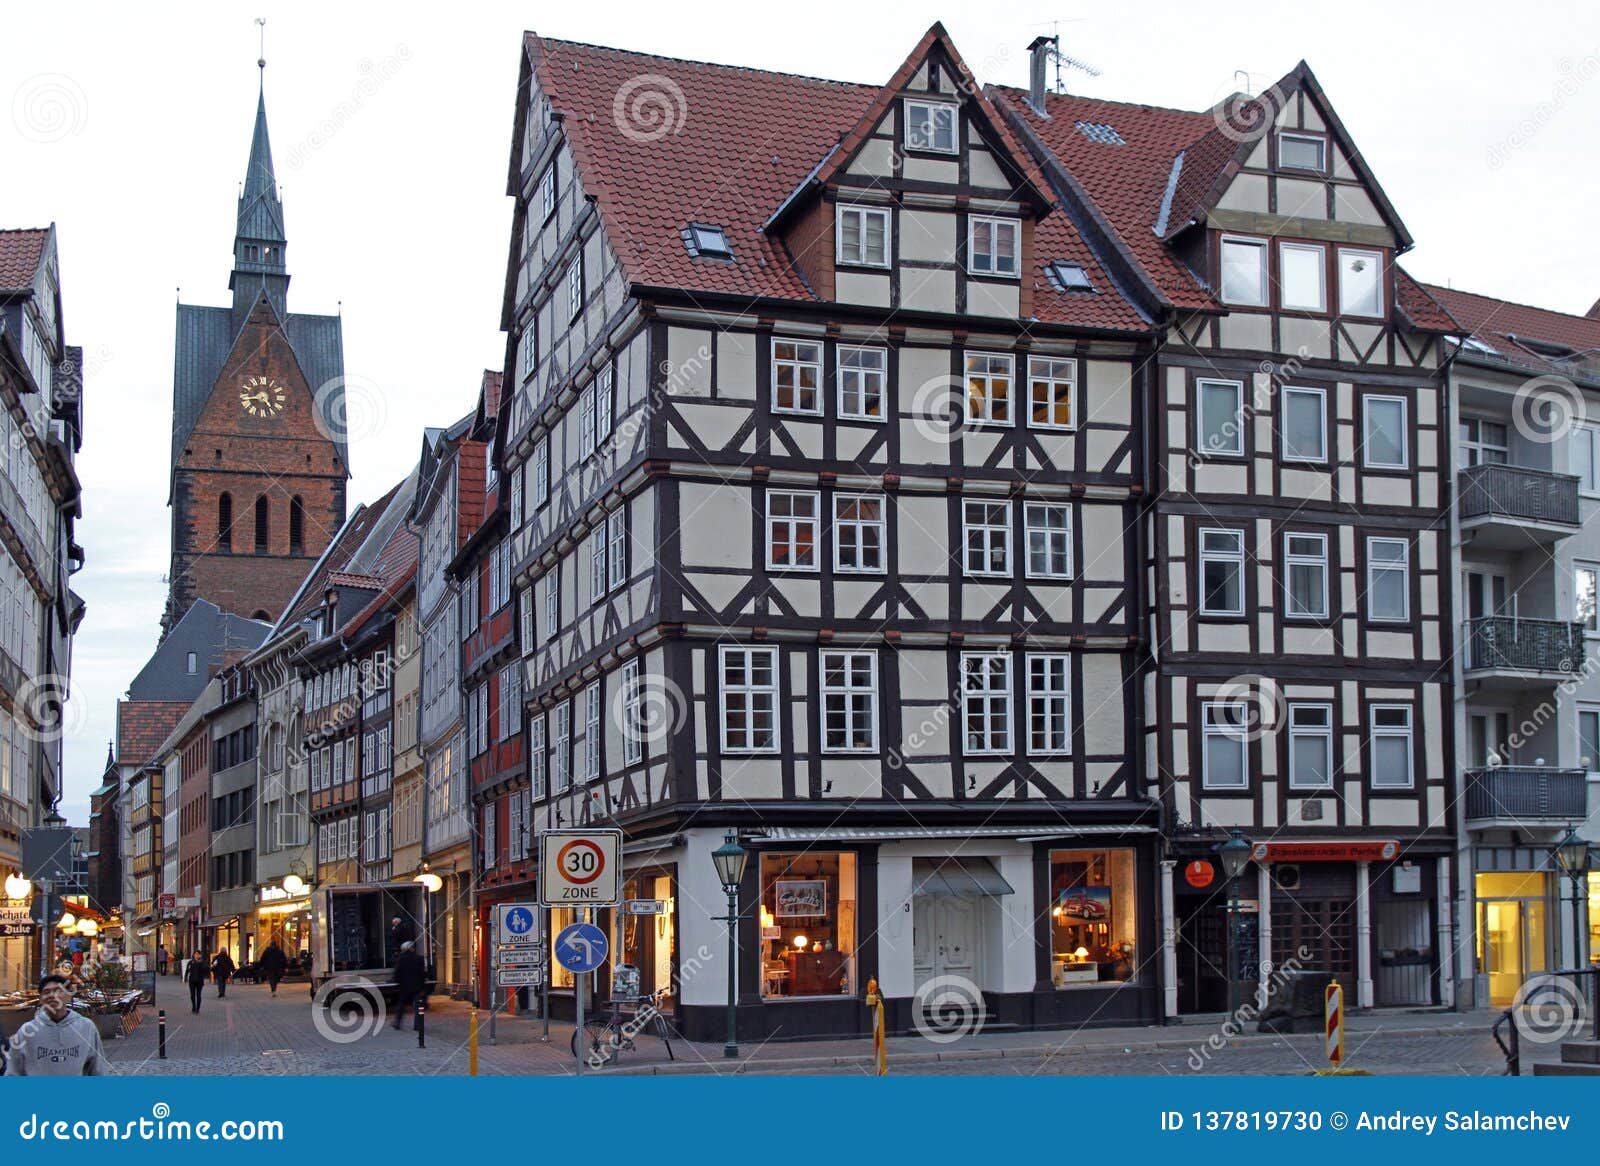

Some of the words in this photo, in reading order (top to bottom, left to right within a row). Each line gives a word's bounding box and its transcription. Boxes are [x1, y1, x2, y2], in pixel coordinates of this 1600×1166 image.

[568, 852, 595, 872] 30
[562, 887, 599, 899] ZONE
[904, 903, 911, 913] 3
[4, 923, 31, 935] Duke
[508, 935, 530, 943] ZONE
[37, 1045, 80, 1060] CHAMPION
